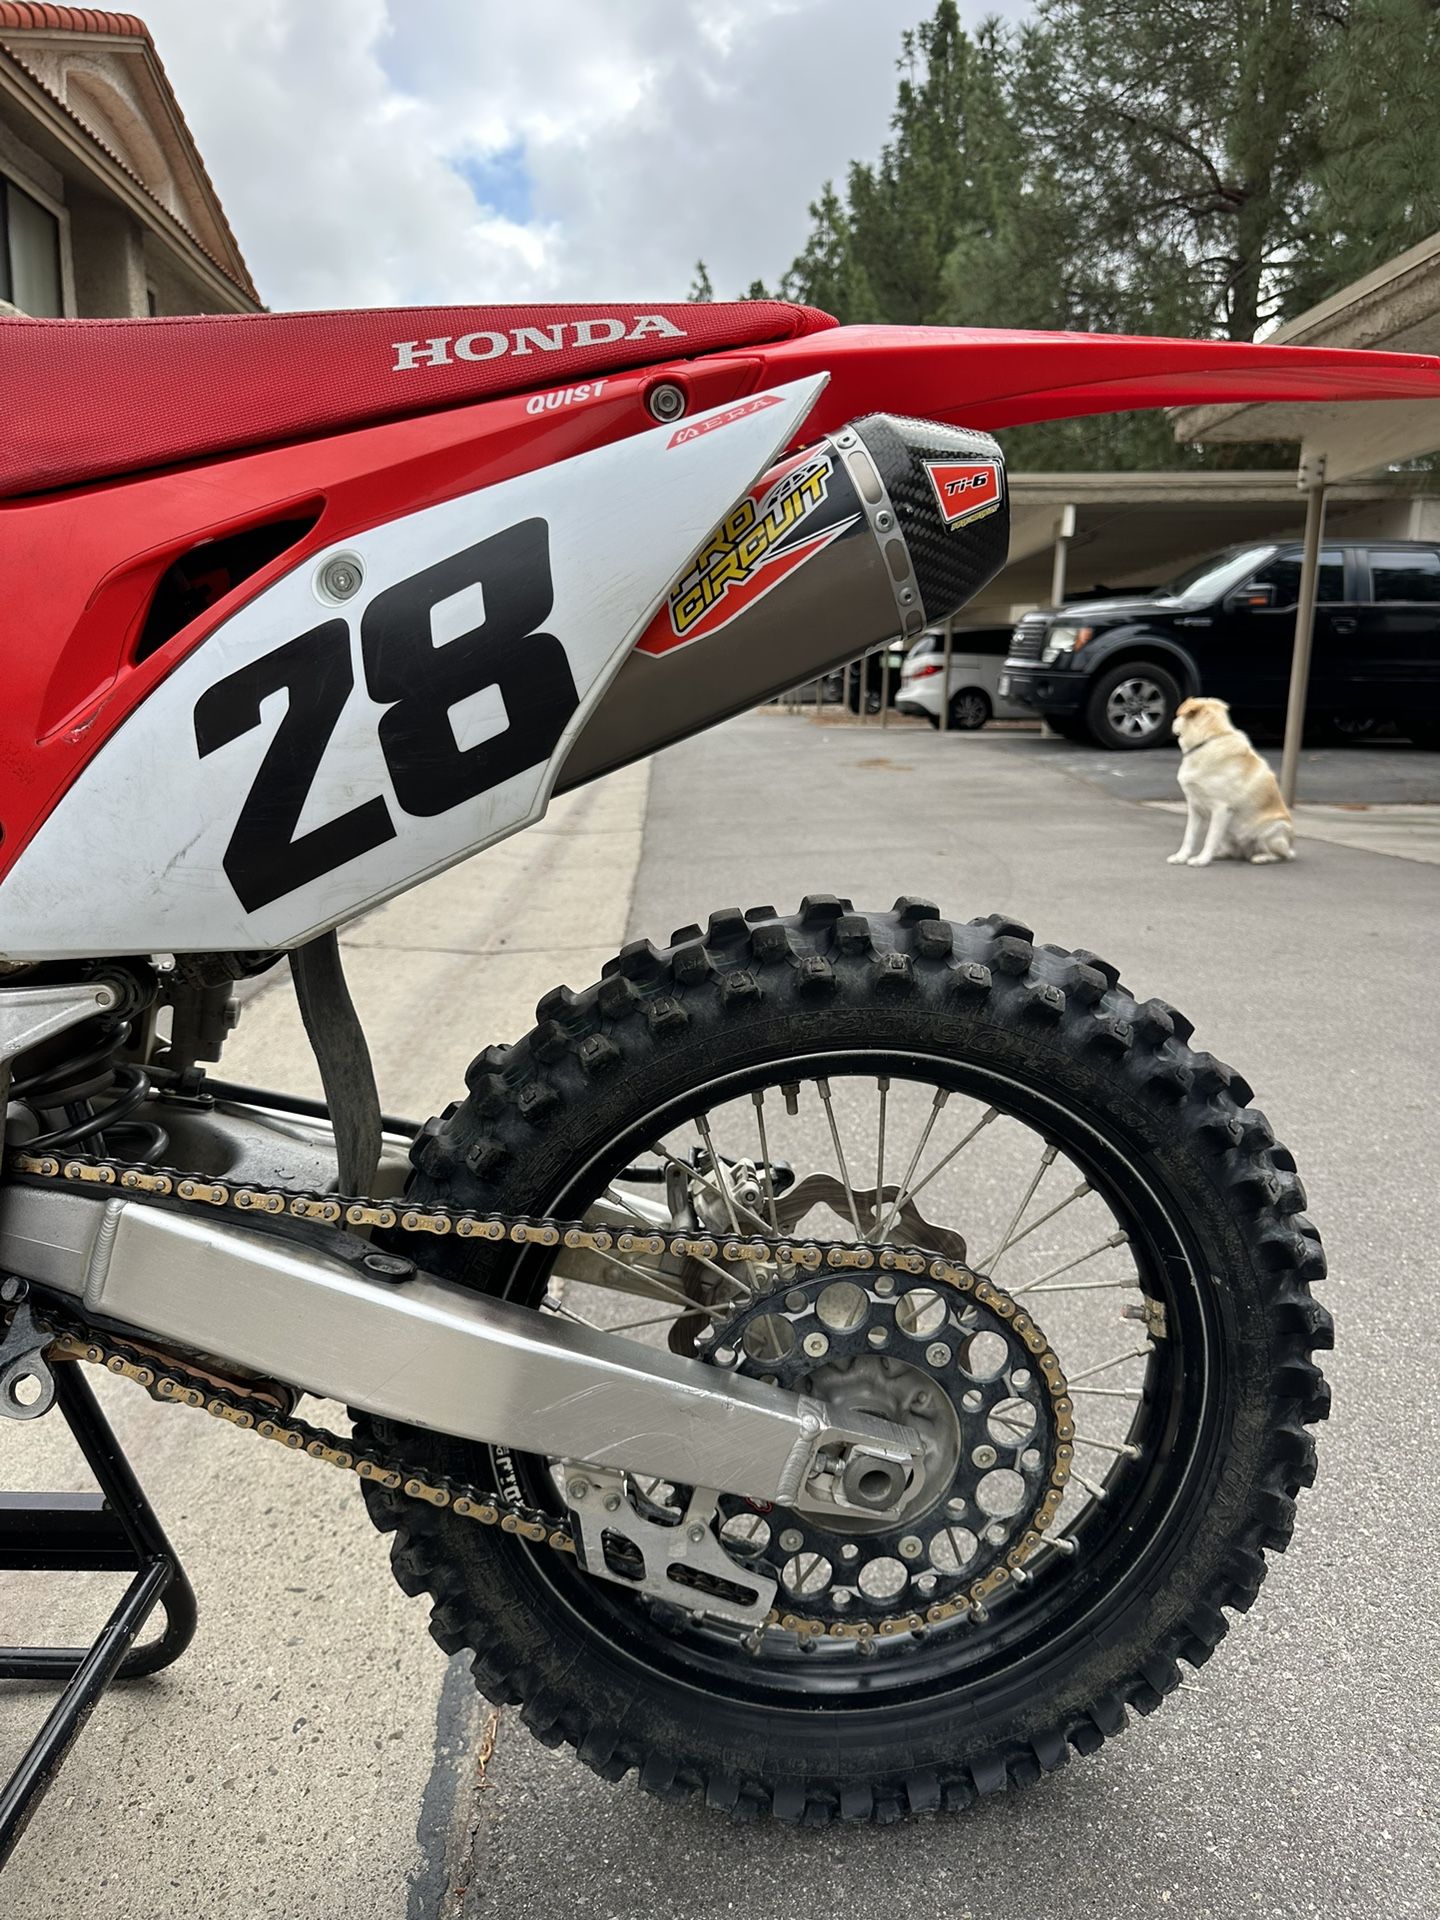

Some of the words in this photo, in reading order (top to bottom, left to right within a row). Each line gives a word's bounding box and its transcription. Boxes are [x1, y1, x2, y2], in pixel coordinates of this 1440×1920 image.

[392, 315, 688, 371] HONDA
[525, 381, 608, 415] QUIST
[945, 472, 990, 497] Ti-6
[673, 465, 830, 632] CIRCUIT
[193, 516, 581, 915] 28
